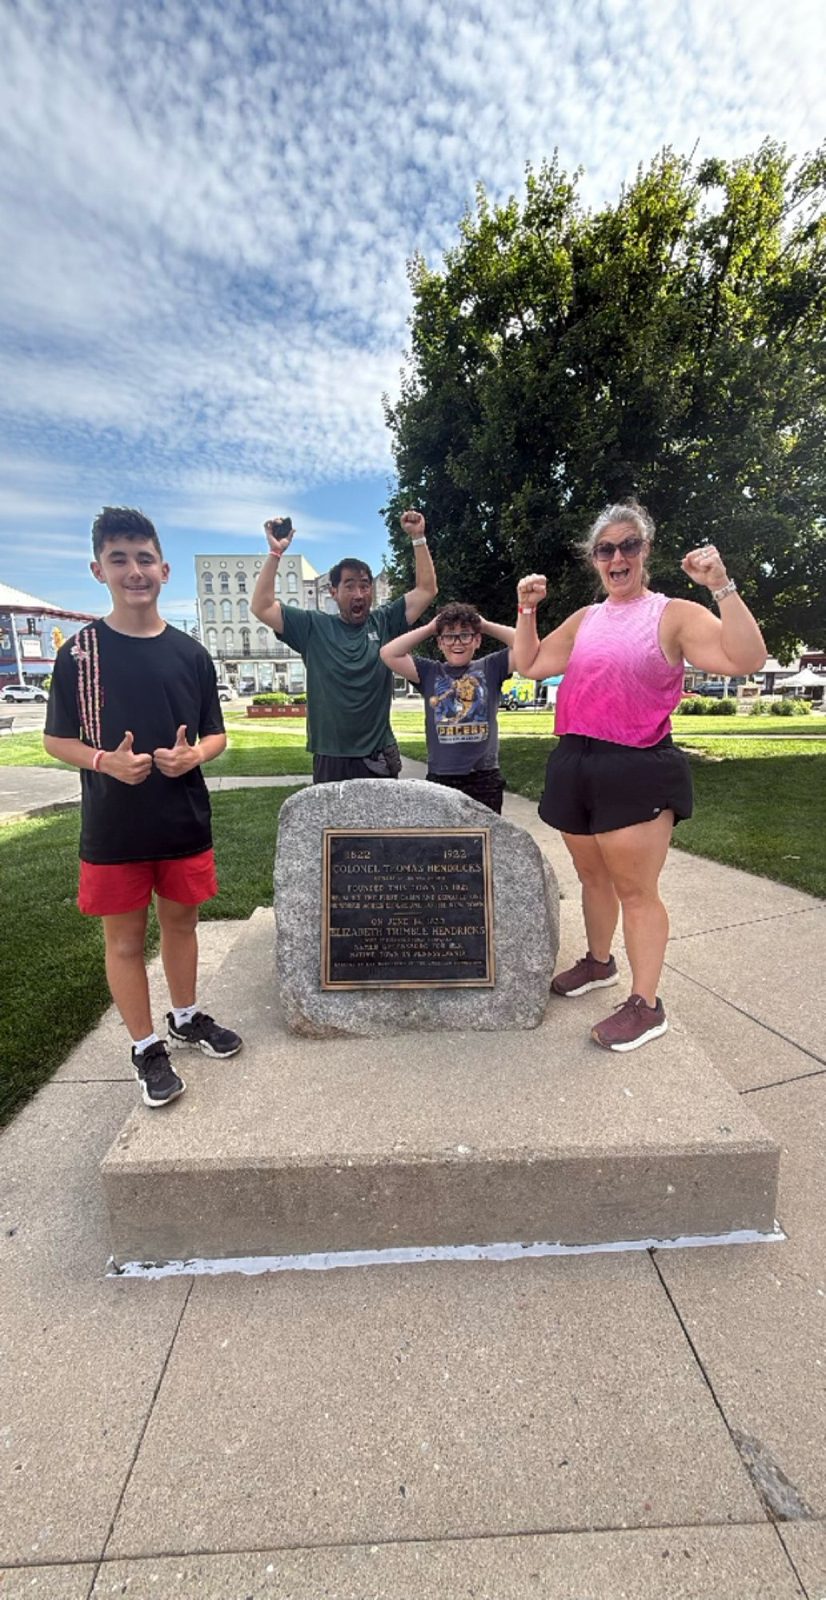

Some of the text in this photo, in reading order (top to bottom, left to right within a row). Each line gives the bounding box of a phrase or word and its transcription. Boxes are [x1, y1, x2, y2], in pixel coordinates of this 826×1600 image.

[444, 849, 467, 859] 1922
[333, 863, 482, 874] COLONEL THOMAS HENDRICKS
[371, 918, 383, 926] ON
[387, 918, 409, 926] JUNE
[330, 926, 486, 937] ELIZABETH TRIMBLE HENDRICKS
